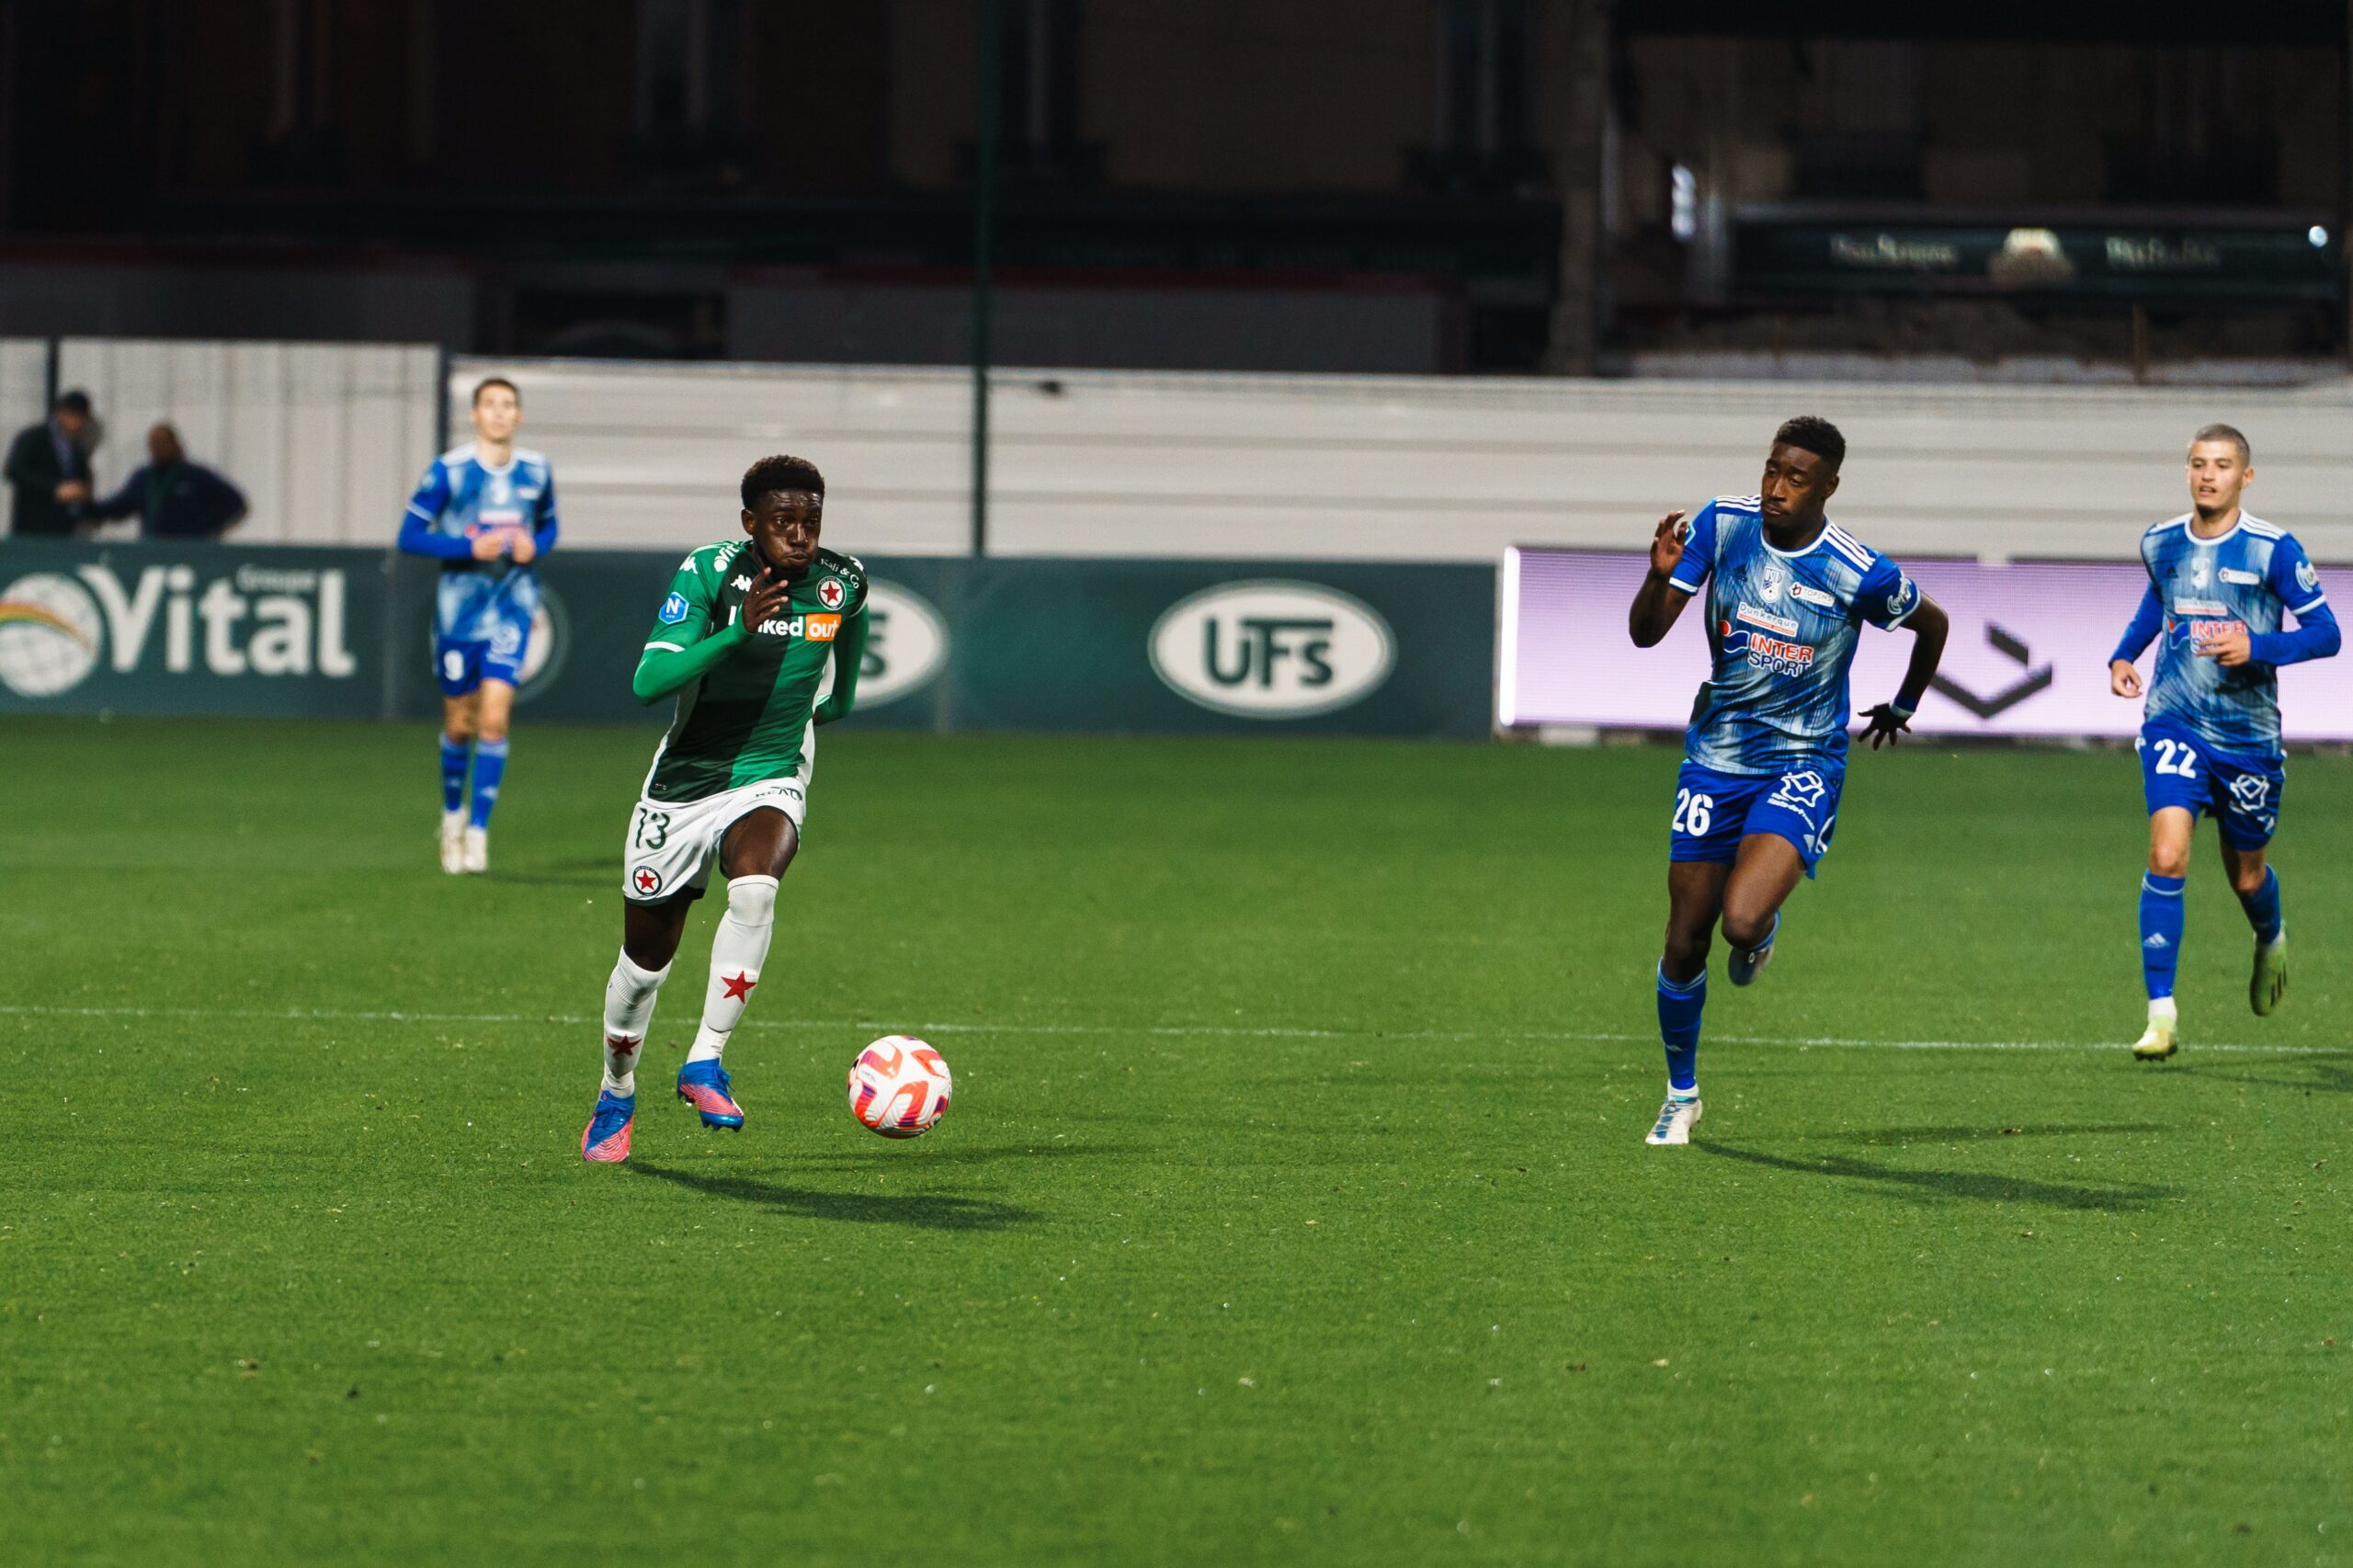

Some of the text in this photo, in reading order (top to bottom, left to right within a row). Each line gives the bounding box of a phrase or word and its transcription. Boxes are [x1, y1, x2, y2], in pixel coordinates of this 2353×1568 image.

[820, 558, 840, 573] Kali
[839, 567, 850, 576] &
[849, 574, 859, 589] Co
[75, 562, 358, 678] Vital
[665, 597, 681, 615] N
[1739, 602, 1798, 629] Dunkerque
[808, 619, 840, 638] out
[1750, 633, 1813, 661] INTER
[1748, 651, 1811, 676] SPORT
[2154, 738, 2197, 779] 22
[1672, 787, 1713, 837] 26
[635, 807, 671, 850] 13
